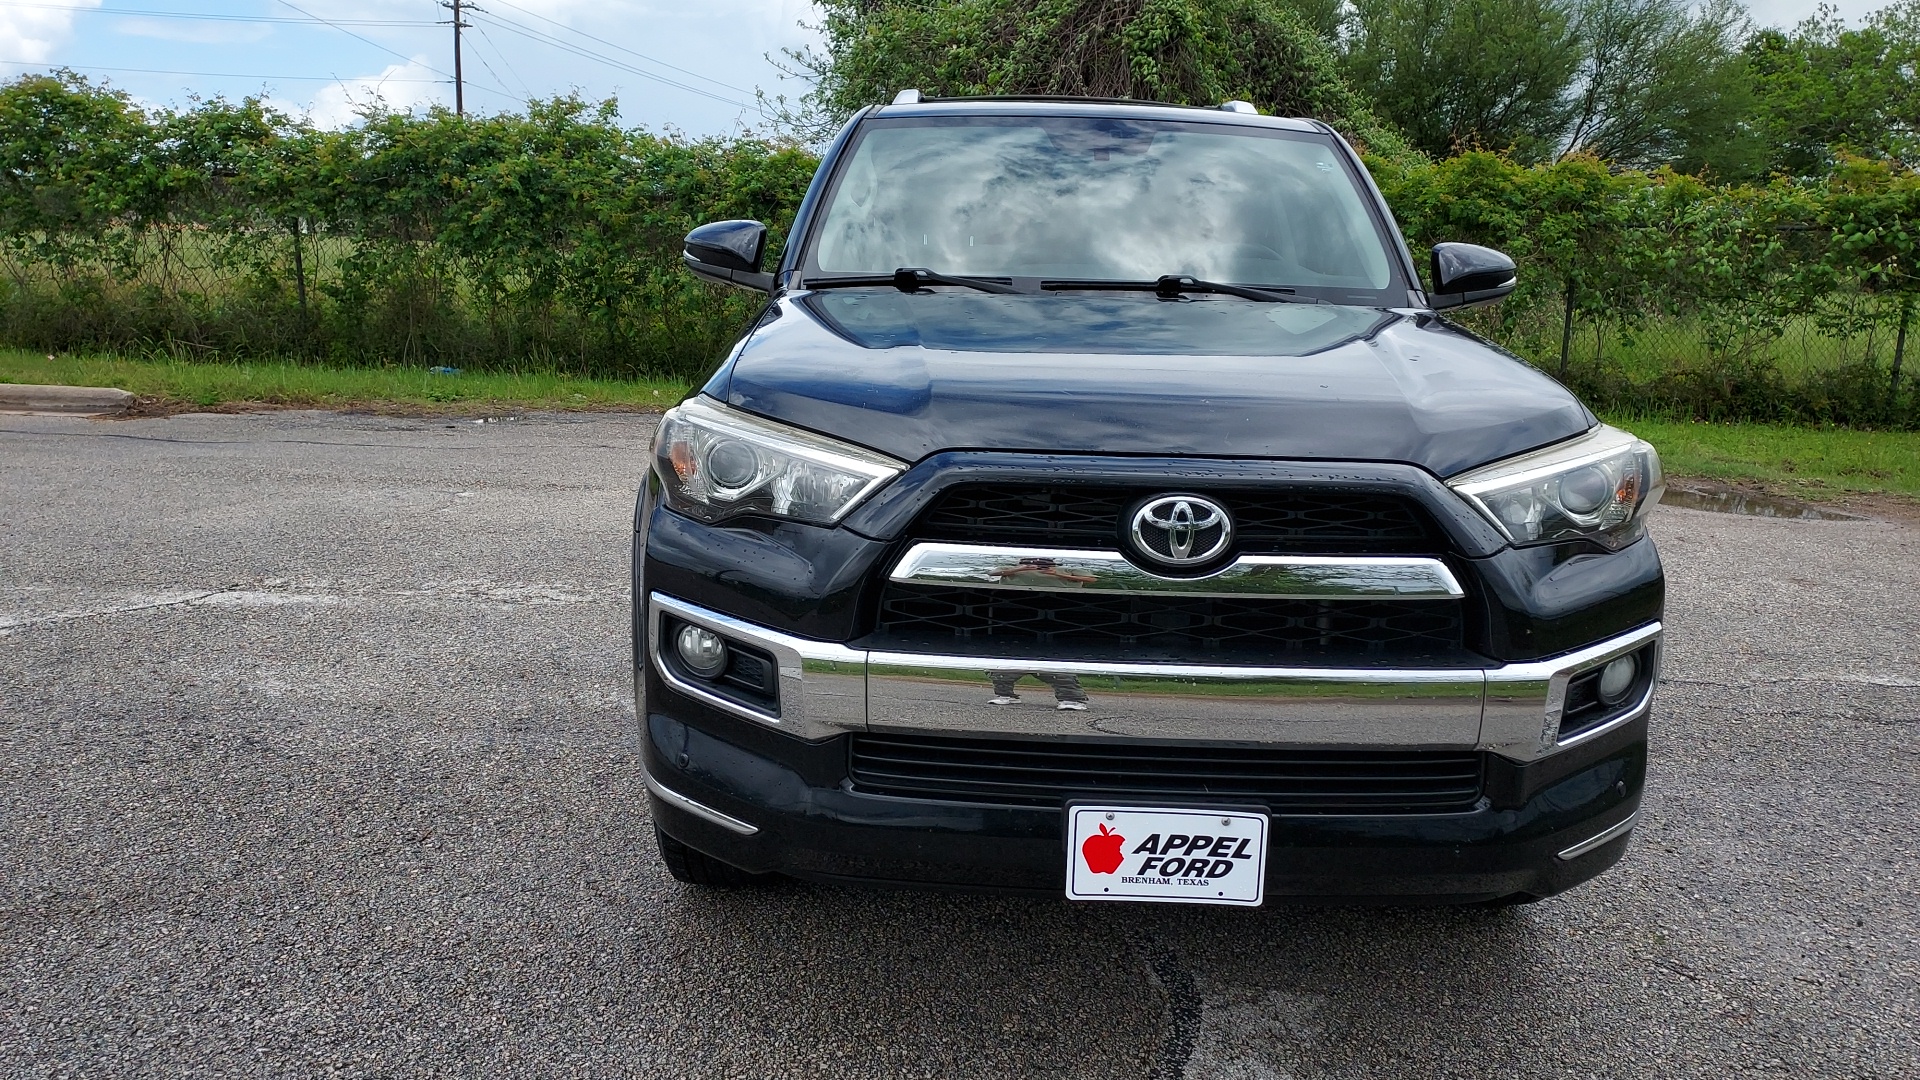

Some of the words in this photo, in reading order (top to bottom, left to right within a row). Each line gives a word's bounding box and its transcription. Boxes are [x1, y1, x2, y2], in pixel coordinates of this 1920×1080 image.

[1131, 834, 1252, 859] APPEL
[1137, 857, 1234, 878] FORD
[1121, 876, 1173, 886] BRENHAM,
[1177, 878, 1209, 886] TEXAS
